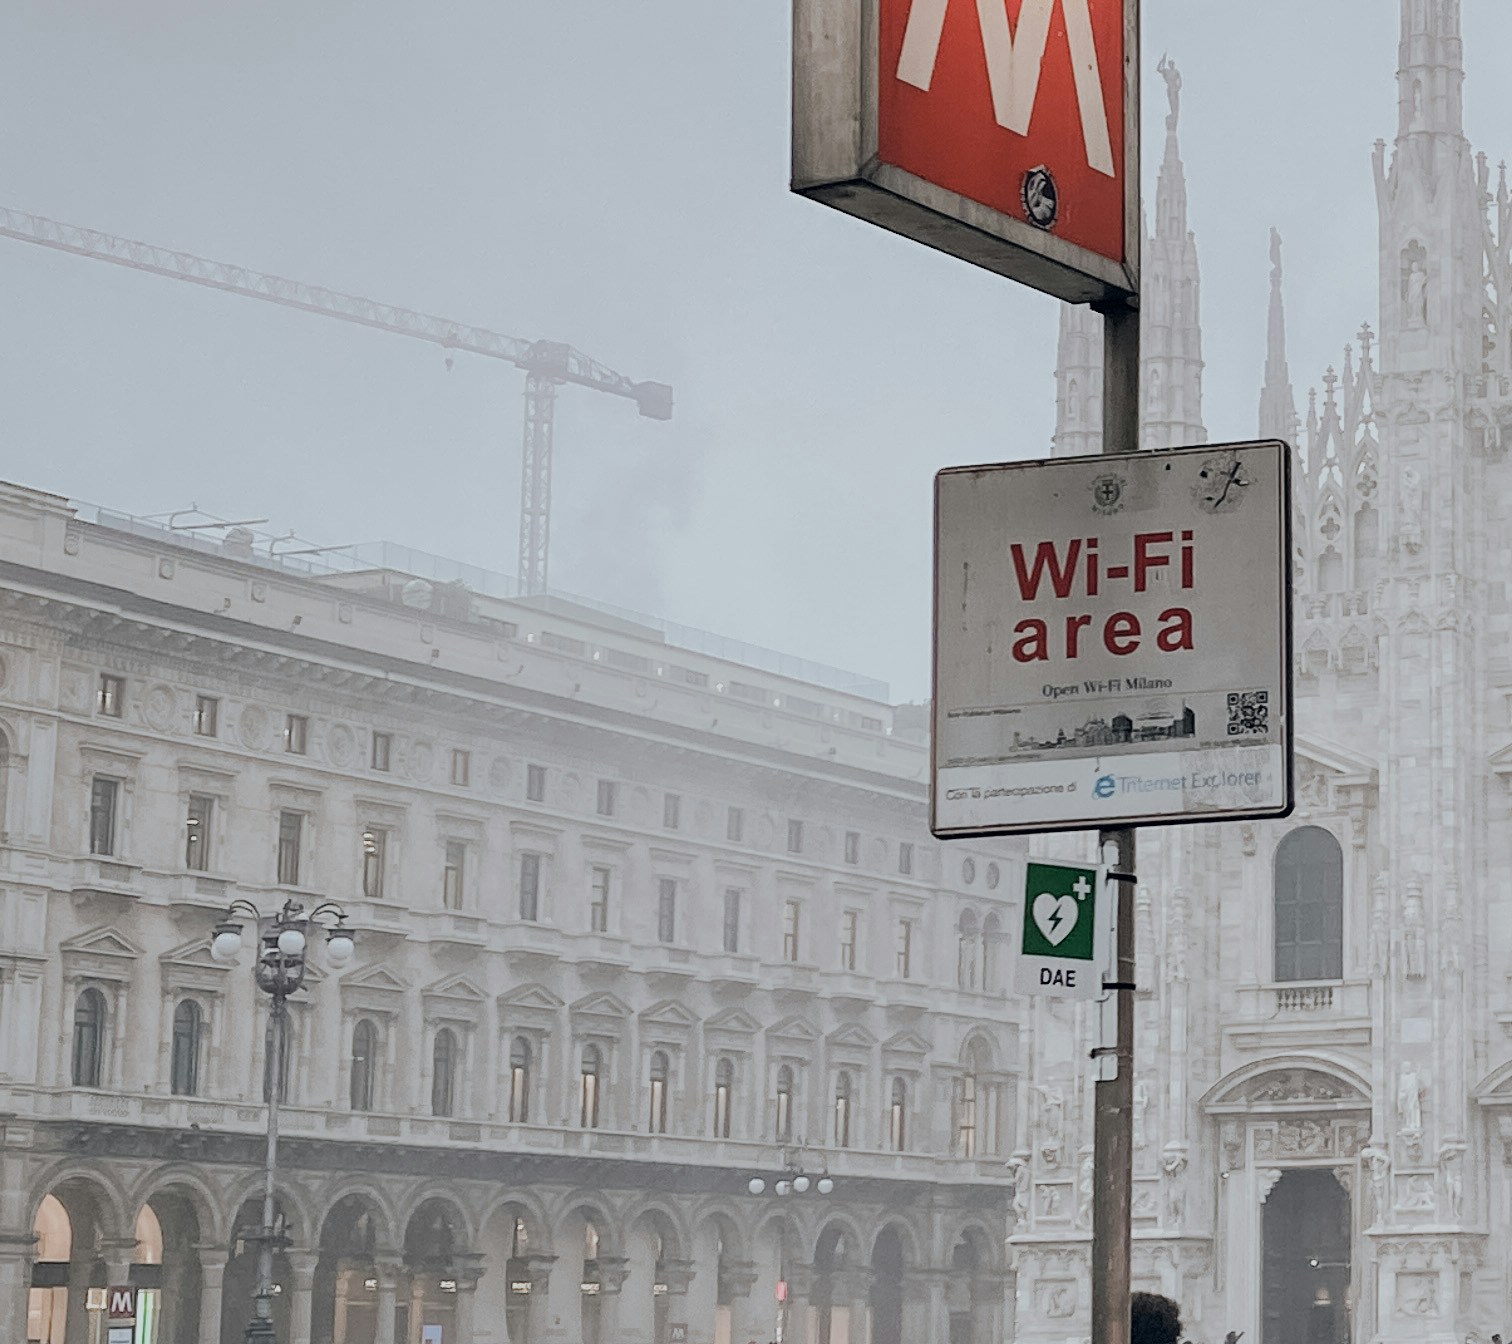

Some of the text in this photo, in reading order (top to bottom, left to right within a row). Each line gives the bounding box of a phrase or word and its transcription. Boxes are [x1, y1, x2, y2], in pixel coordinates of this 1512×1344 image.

[1010, 530, 1194, 601] Wi-Fi
[1011, 607, 1194, 663] area
[1042, 677, 1173, 699] Open Wi-Fi Milano
[1119, 775, 1187, 793] Internet
[1039, 967, 1077, 988] DAE
[111, 1292, 133, 1312] M
